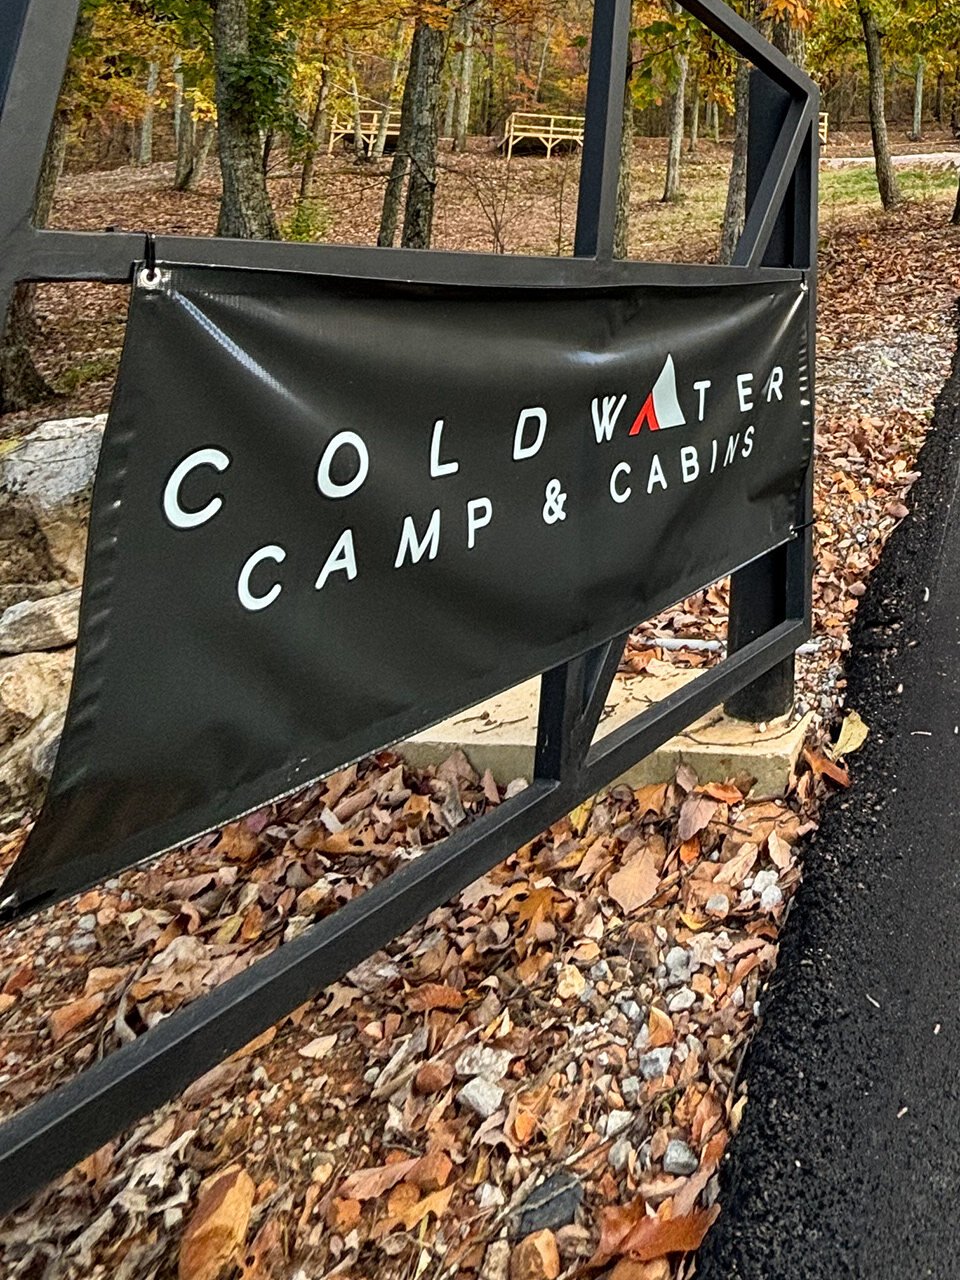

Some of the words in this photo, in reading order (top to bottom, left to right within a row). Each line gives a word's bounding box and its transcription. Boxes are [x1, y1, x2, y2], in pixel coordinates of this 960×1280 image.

[163, 352, 785, 529] COLDWATER
[237, 497, 493, 611] CAMP
[542, 477, 568, 525] &
[609, 425, 756, 505] CABINS
